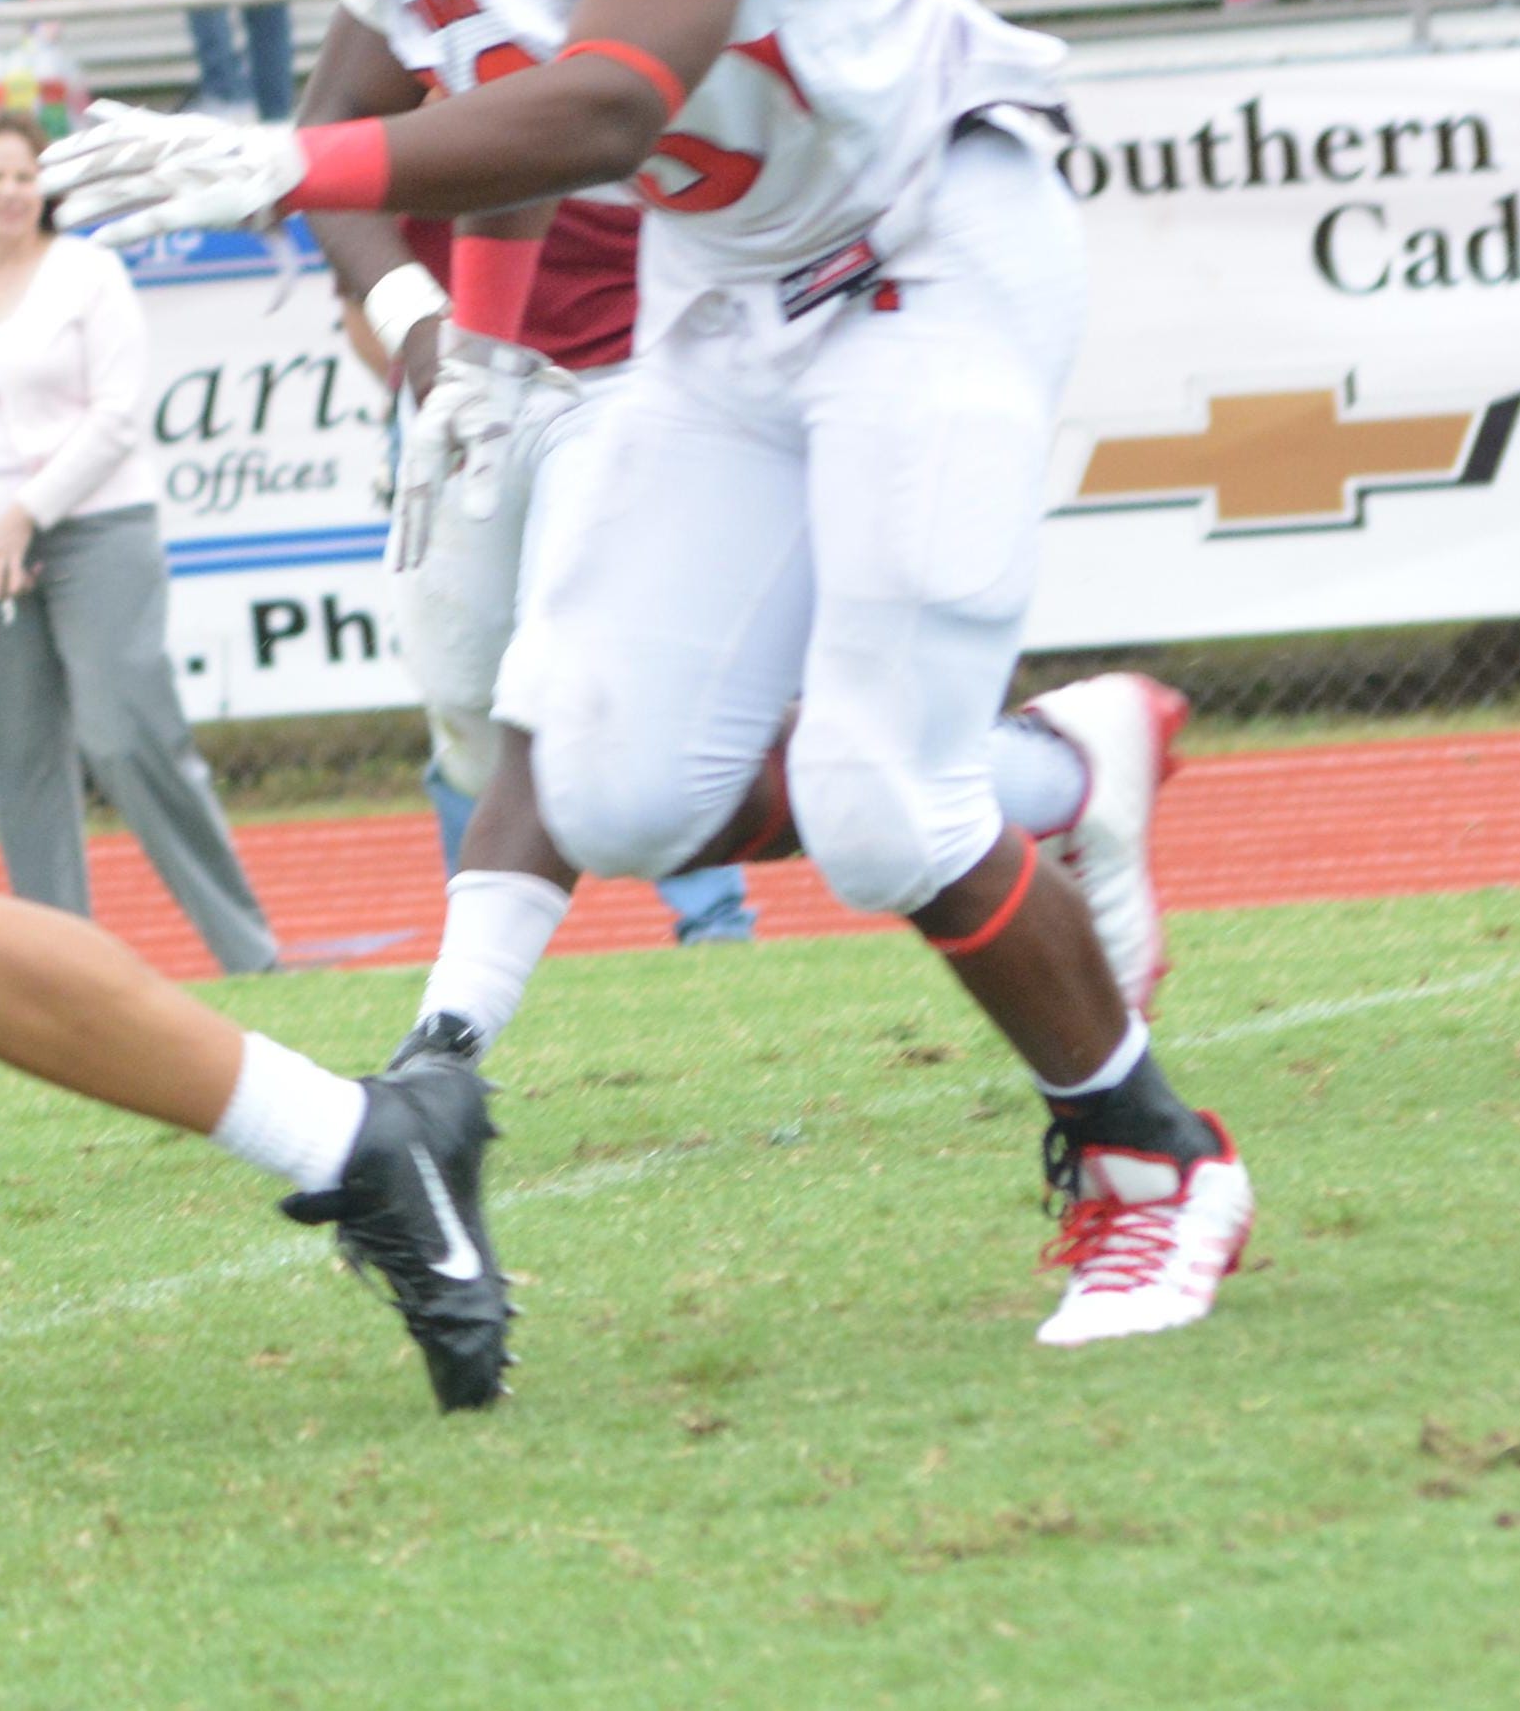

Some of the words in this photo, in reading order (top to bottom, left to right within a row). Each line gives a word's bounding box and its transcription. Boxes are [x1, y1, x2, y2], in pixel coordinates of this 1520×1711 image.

[1056, 93, 1499, 201] outhern
[165, 447, 340, 516] Offices
[249, 593, 404, 668] Ph
